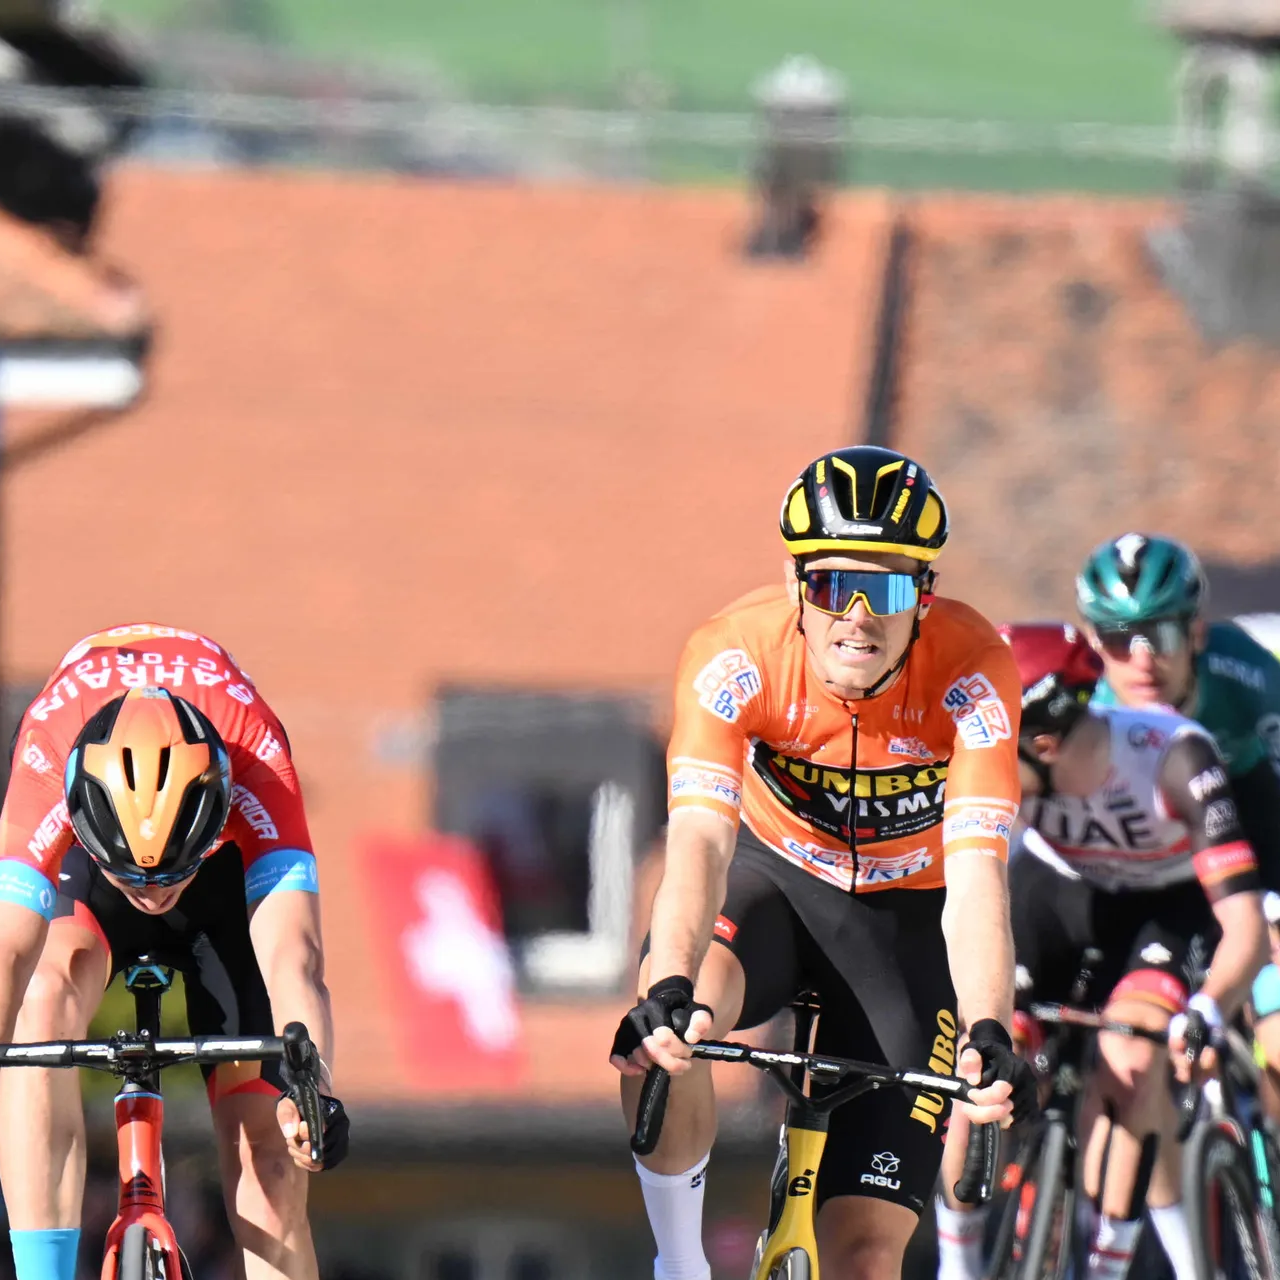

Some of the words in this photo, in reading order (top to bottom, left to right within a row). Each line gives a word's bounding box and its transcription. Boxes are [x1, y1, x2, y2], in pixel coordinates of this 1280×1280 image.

[30, 664, 254, 722] BAHRAIN
[944, 687, 991, 745] SPORT!
[958, 677, 1008, 736] JOUEZ
[772, 754, 949, 798] JUMBO
[232, 783, 280, 840] ERIDA
[1033, 799, 1153, 849] UAE
[816, 1062, 840, 1072] GARMIN
[859, 1173, 902, 1191] AGU
